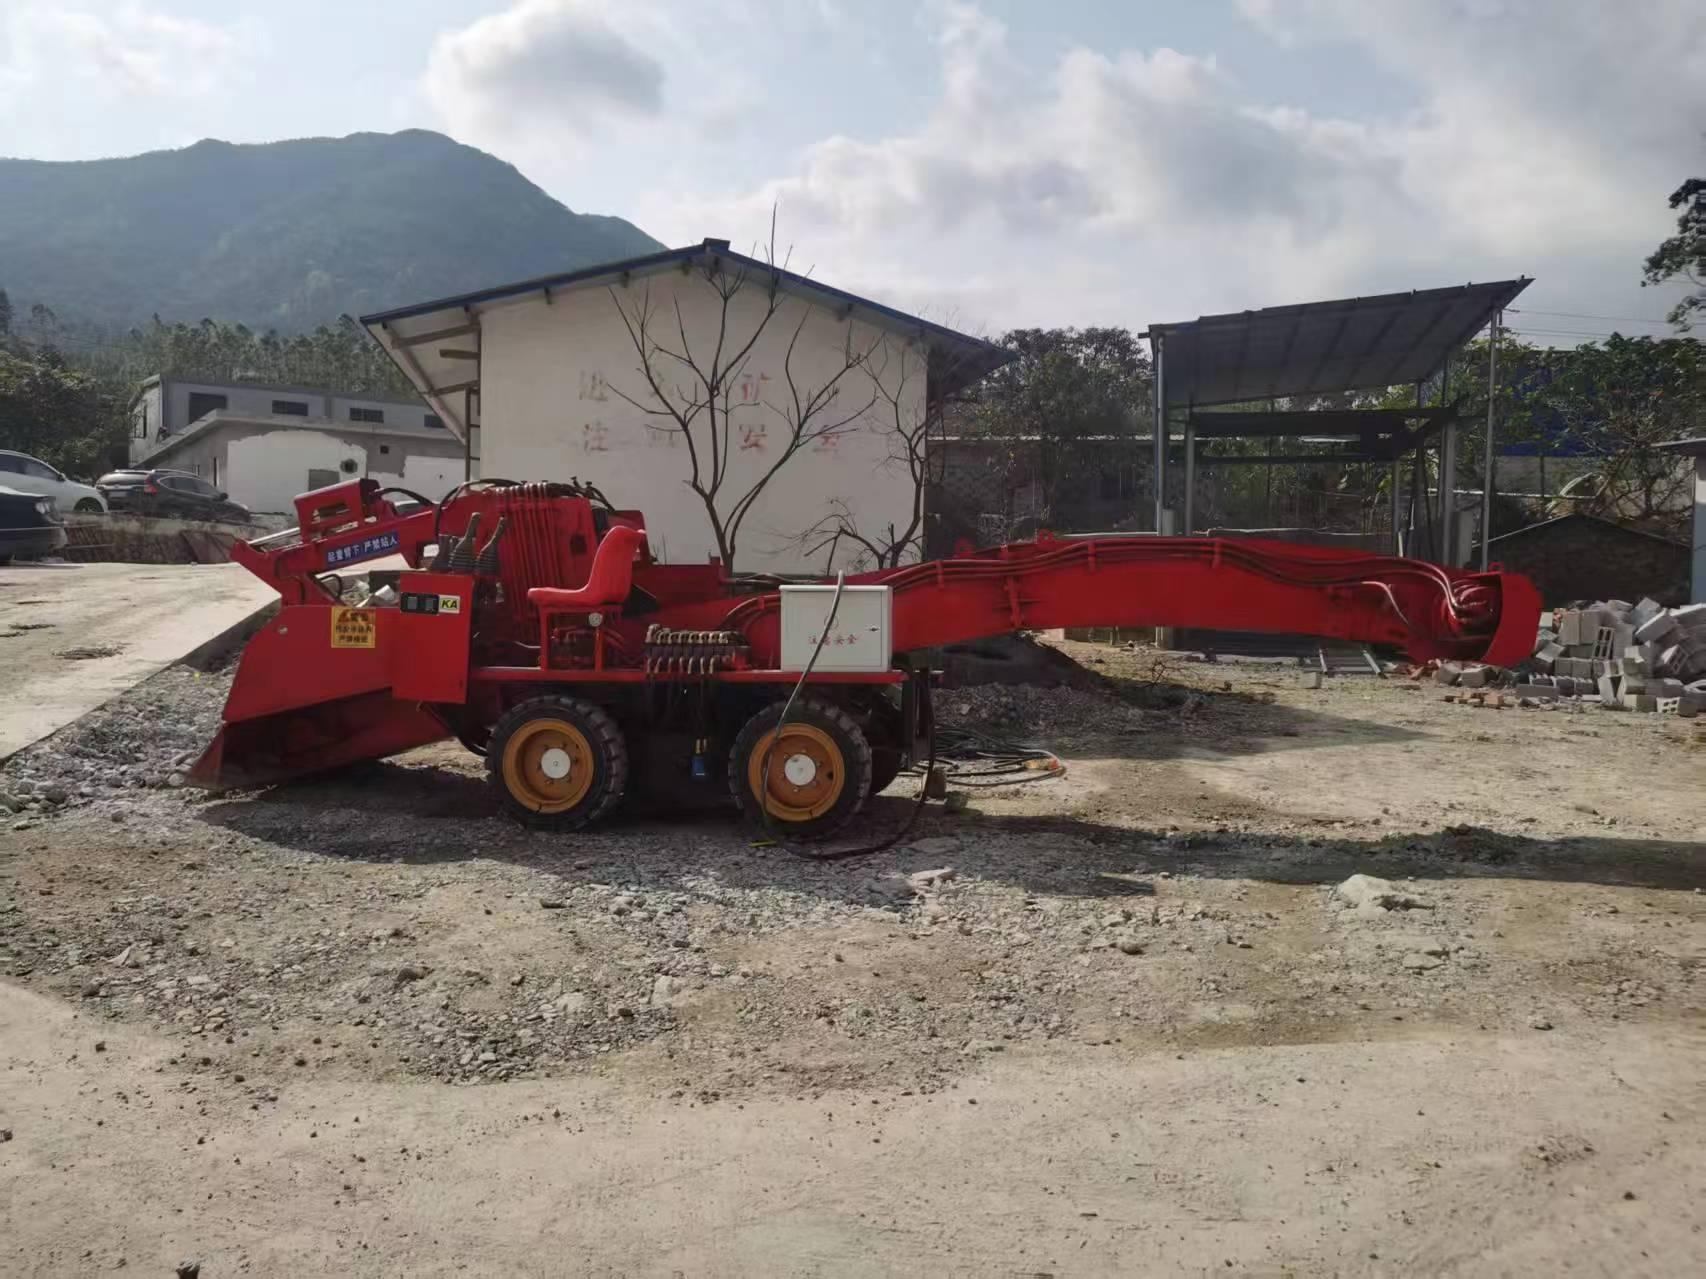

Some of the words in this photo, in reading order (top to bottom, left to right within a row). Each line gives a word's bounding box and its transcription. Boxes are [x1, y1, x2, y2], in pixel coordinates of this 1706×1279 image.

[328, 545, 360, 562] 起重臂下
[364, 535, 397, 553] 严禁站人
[442, 600, 458, 609] KA
